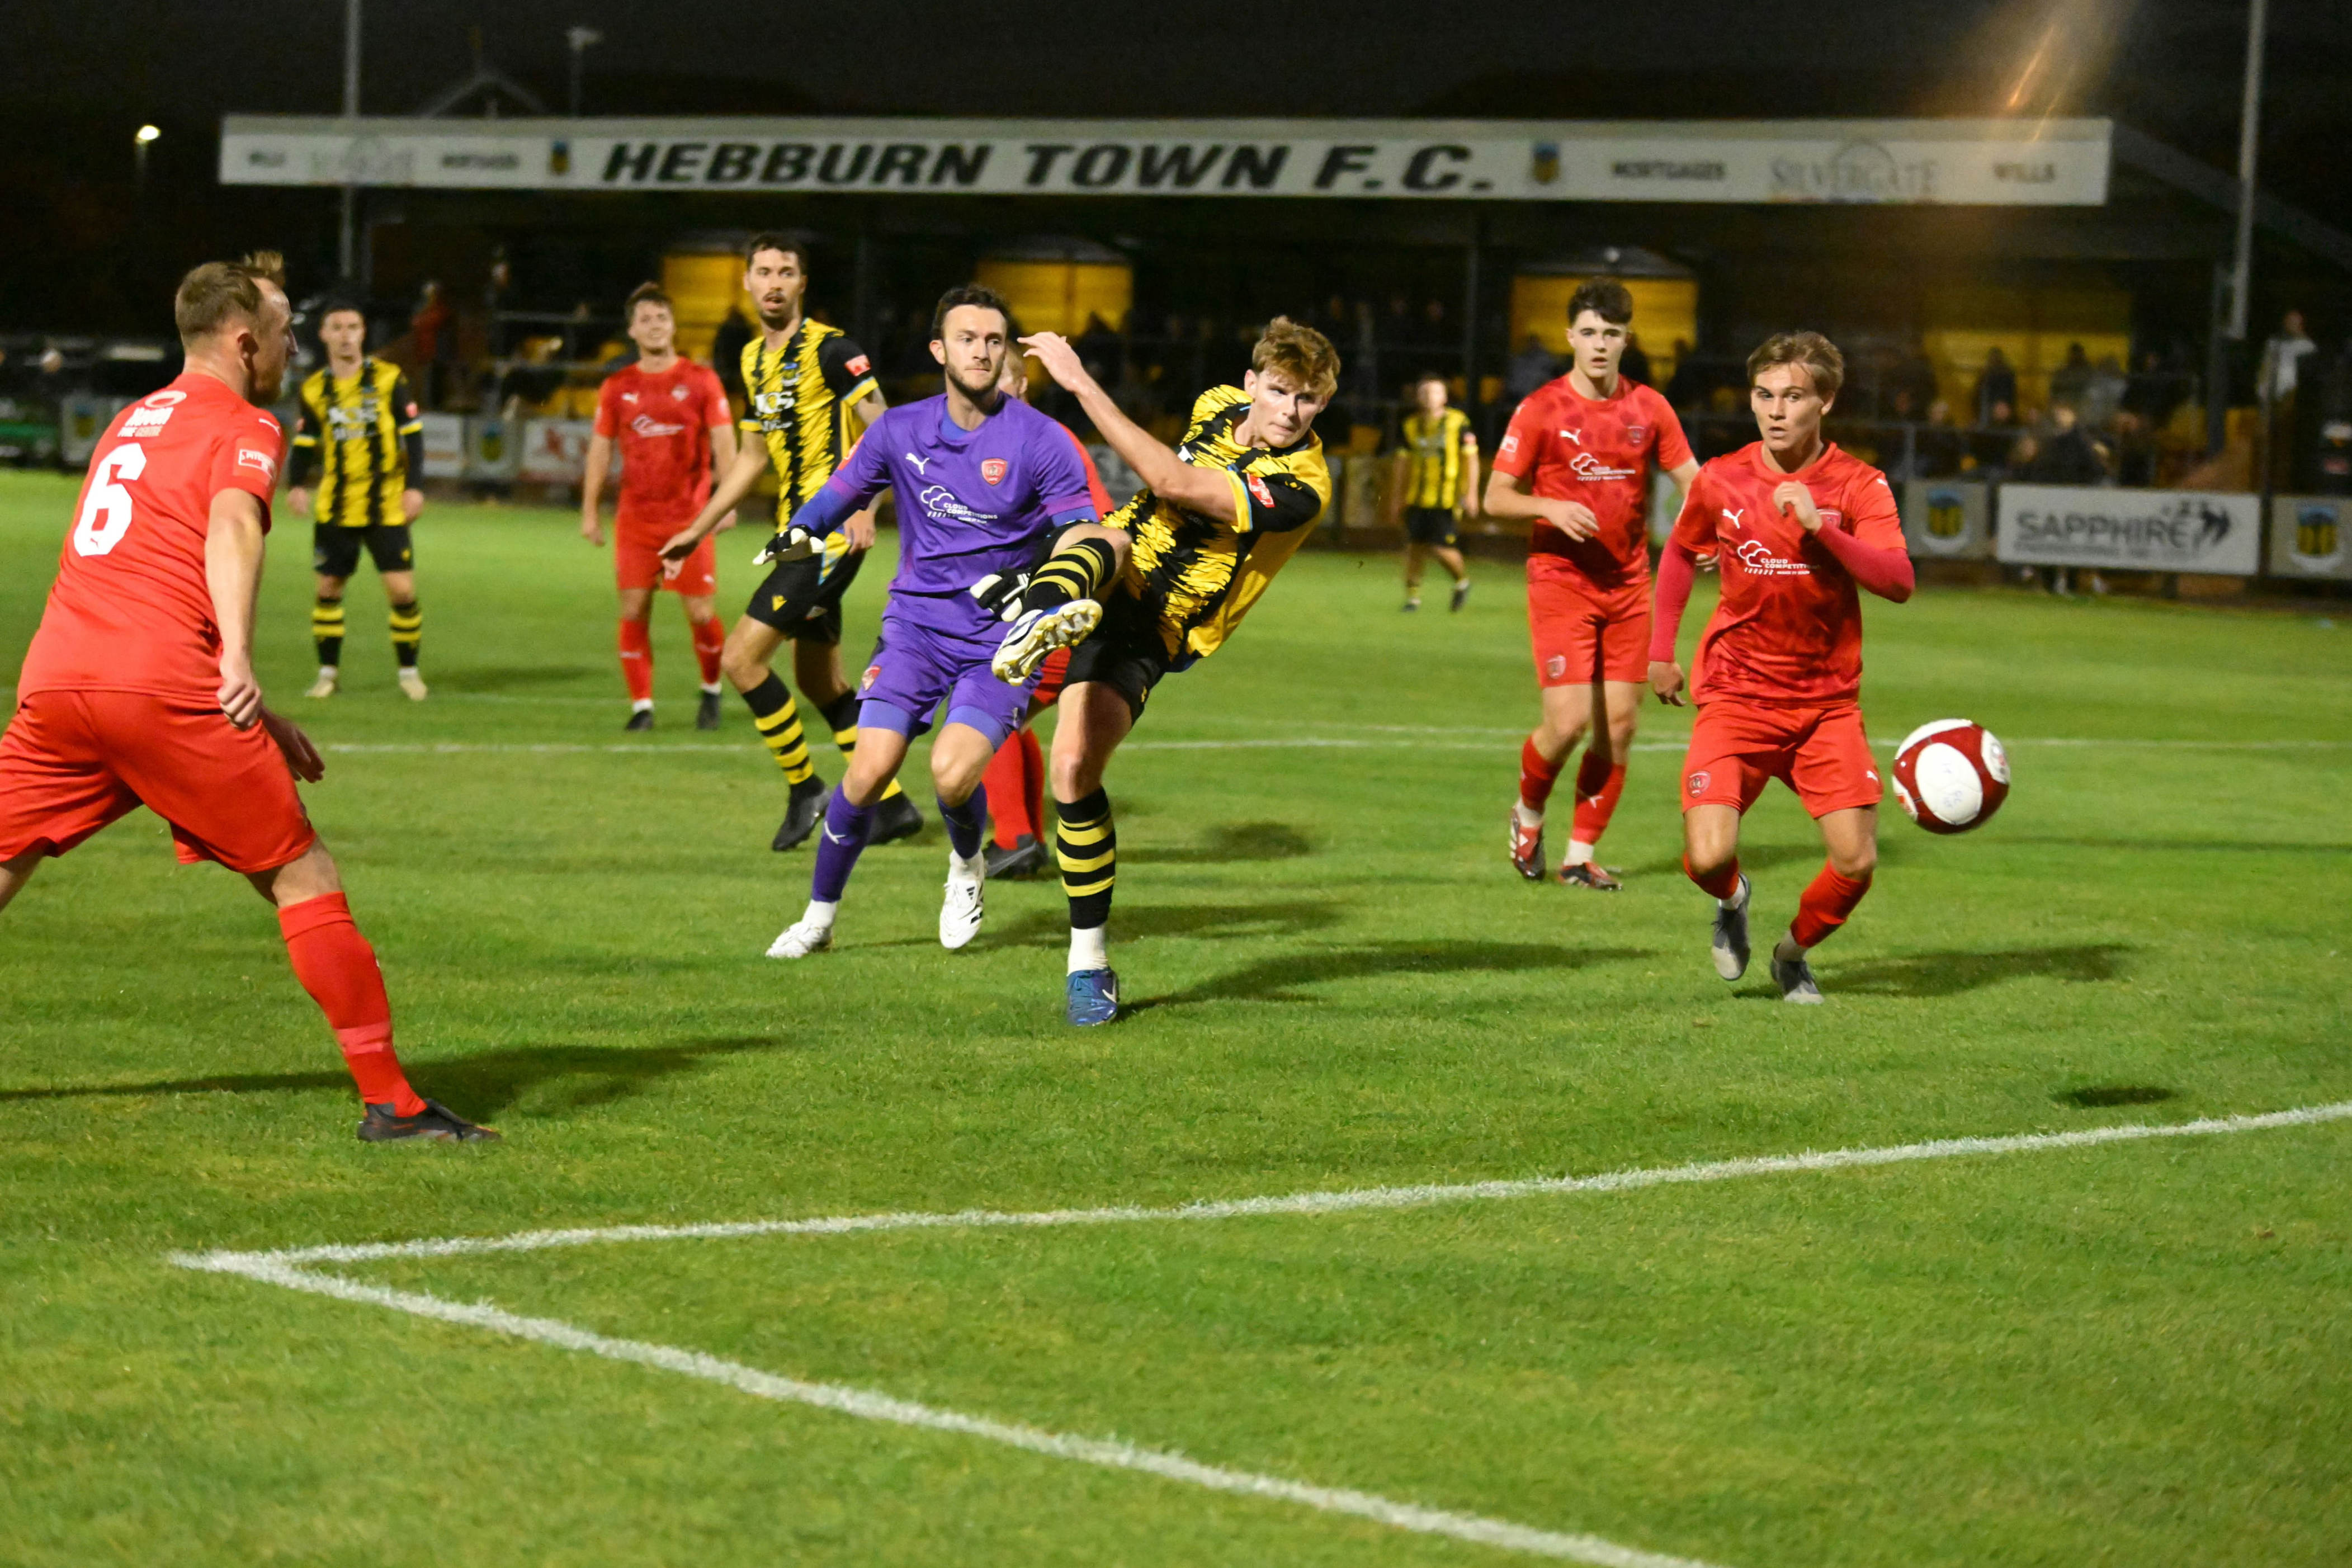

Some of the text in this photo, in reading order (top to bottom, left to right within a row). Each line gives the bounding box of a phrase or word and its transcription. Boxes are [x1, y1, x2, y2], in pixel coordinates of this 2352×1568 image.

[602, 143, 1492, 192] HEBBURN TOWN F.C.
[73, 442, 147, 557] 6
[943, 502, 968, 511] CLOUD
[947, 508, 998, 519] COMPETITIONS
[2016, 511, 2186, 549] SAPPHIRE
